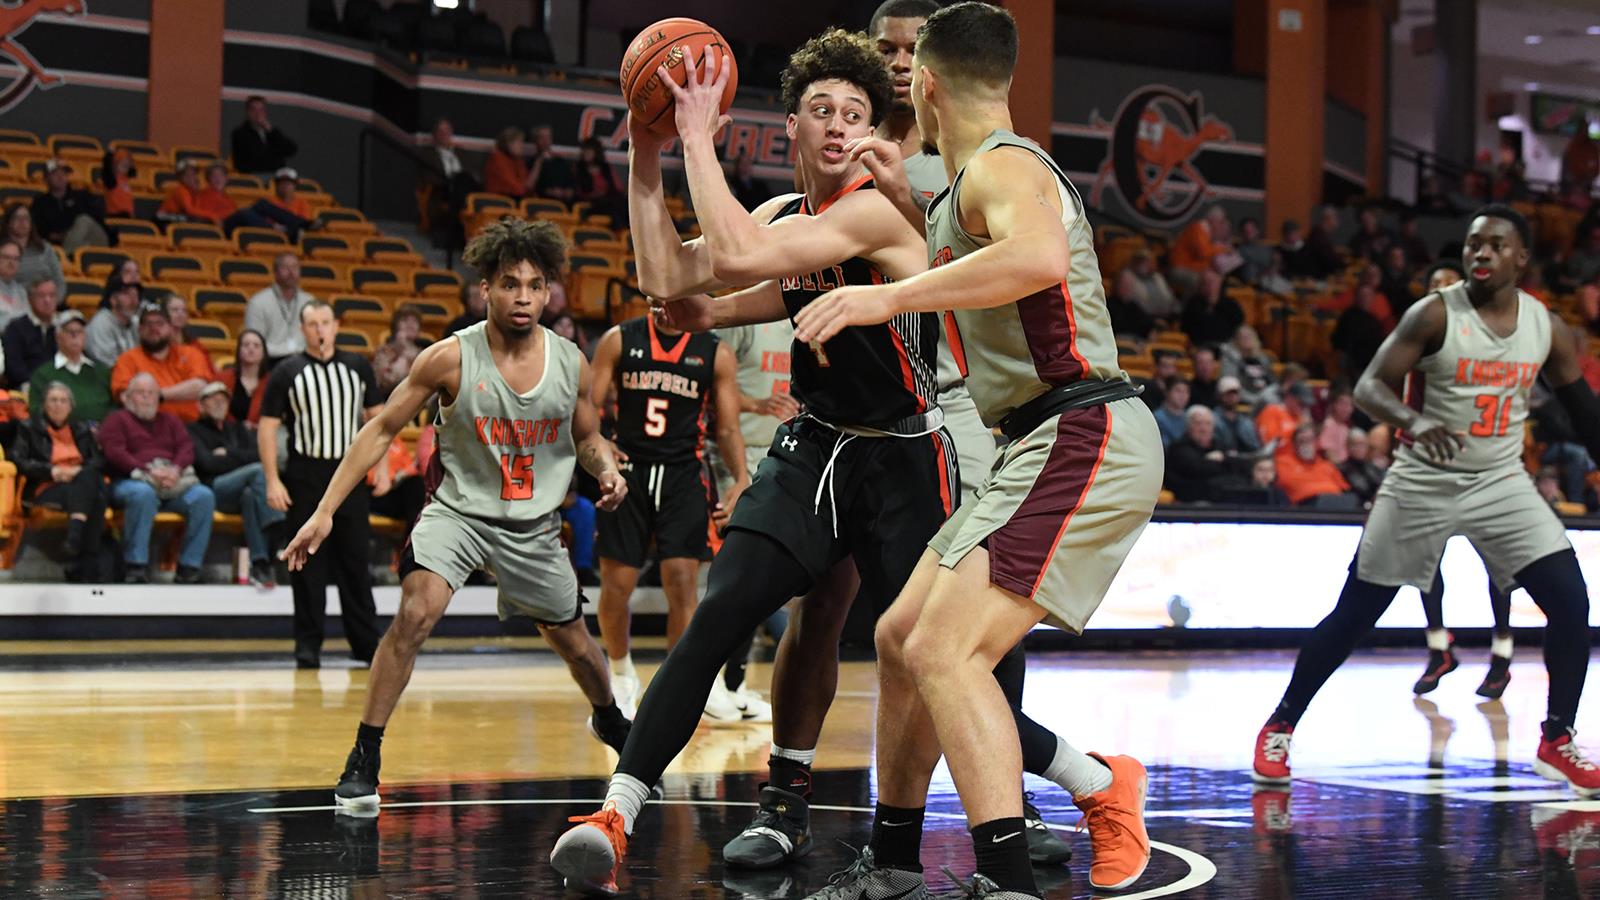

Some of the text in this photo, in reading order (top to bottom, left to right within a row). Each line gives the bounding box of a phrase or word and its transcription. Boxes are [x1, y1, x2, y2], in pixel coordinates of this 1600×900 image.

[622, 371, 699, 399] CAMPBELL
[474, 416, 560, 448] KNIGHTS
[644, 397, 669, 437] 5
[1469, 394, 1513, 438] 31
[500, 453, 534, 501] 15
